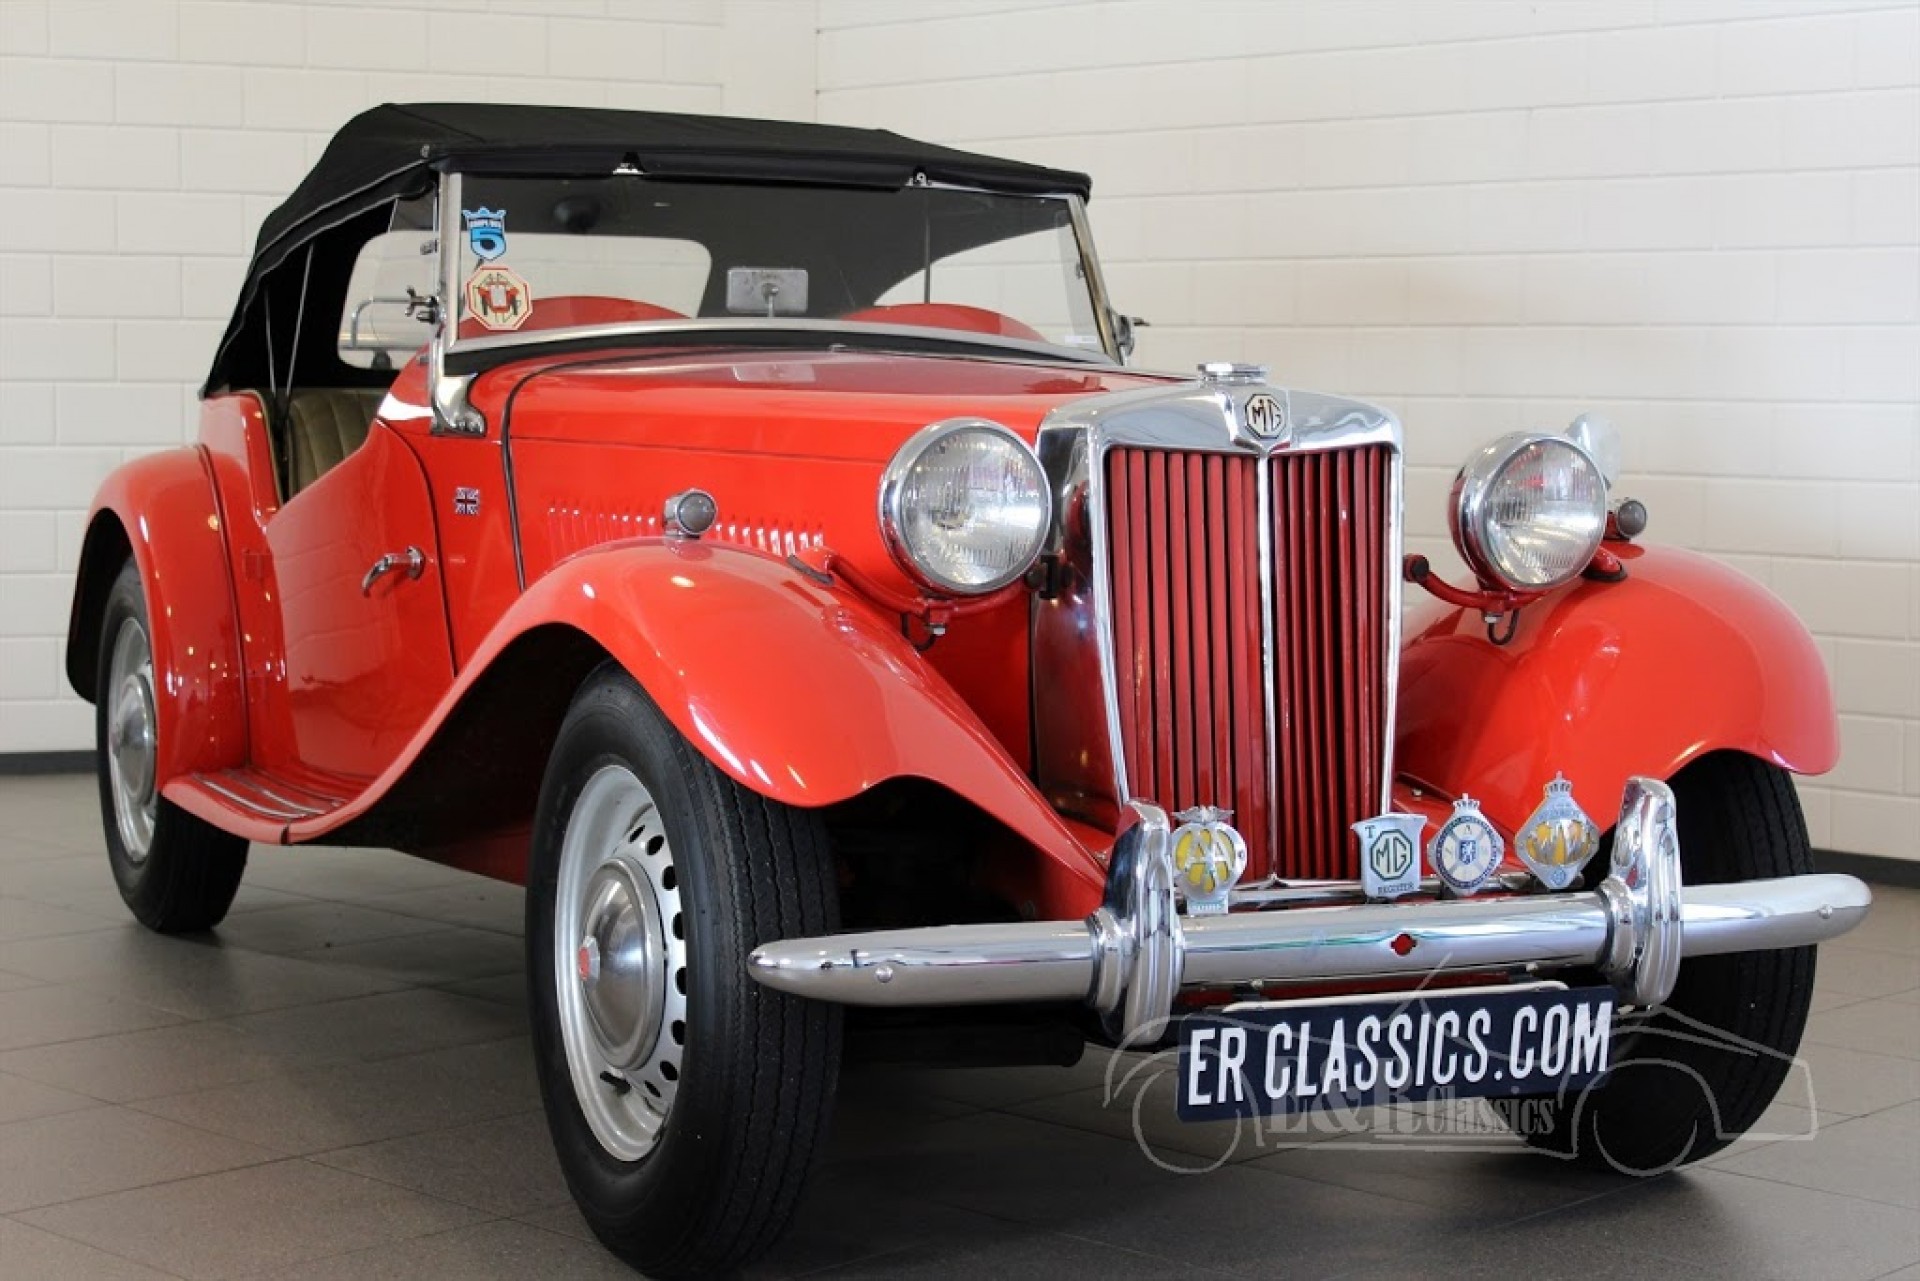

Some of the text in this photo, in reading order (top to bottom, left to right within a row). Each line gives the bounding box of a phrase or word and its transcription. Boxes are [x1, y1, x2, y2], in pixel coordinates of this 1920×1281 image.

[1251, 398, 1281, 432] MG
[1364, 824, 1376, 839] T
[1375, 835, 1408, 874] MG
[1188, 1001, 1614, 1106] ER CLASSICS.COM
